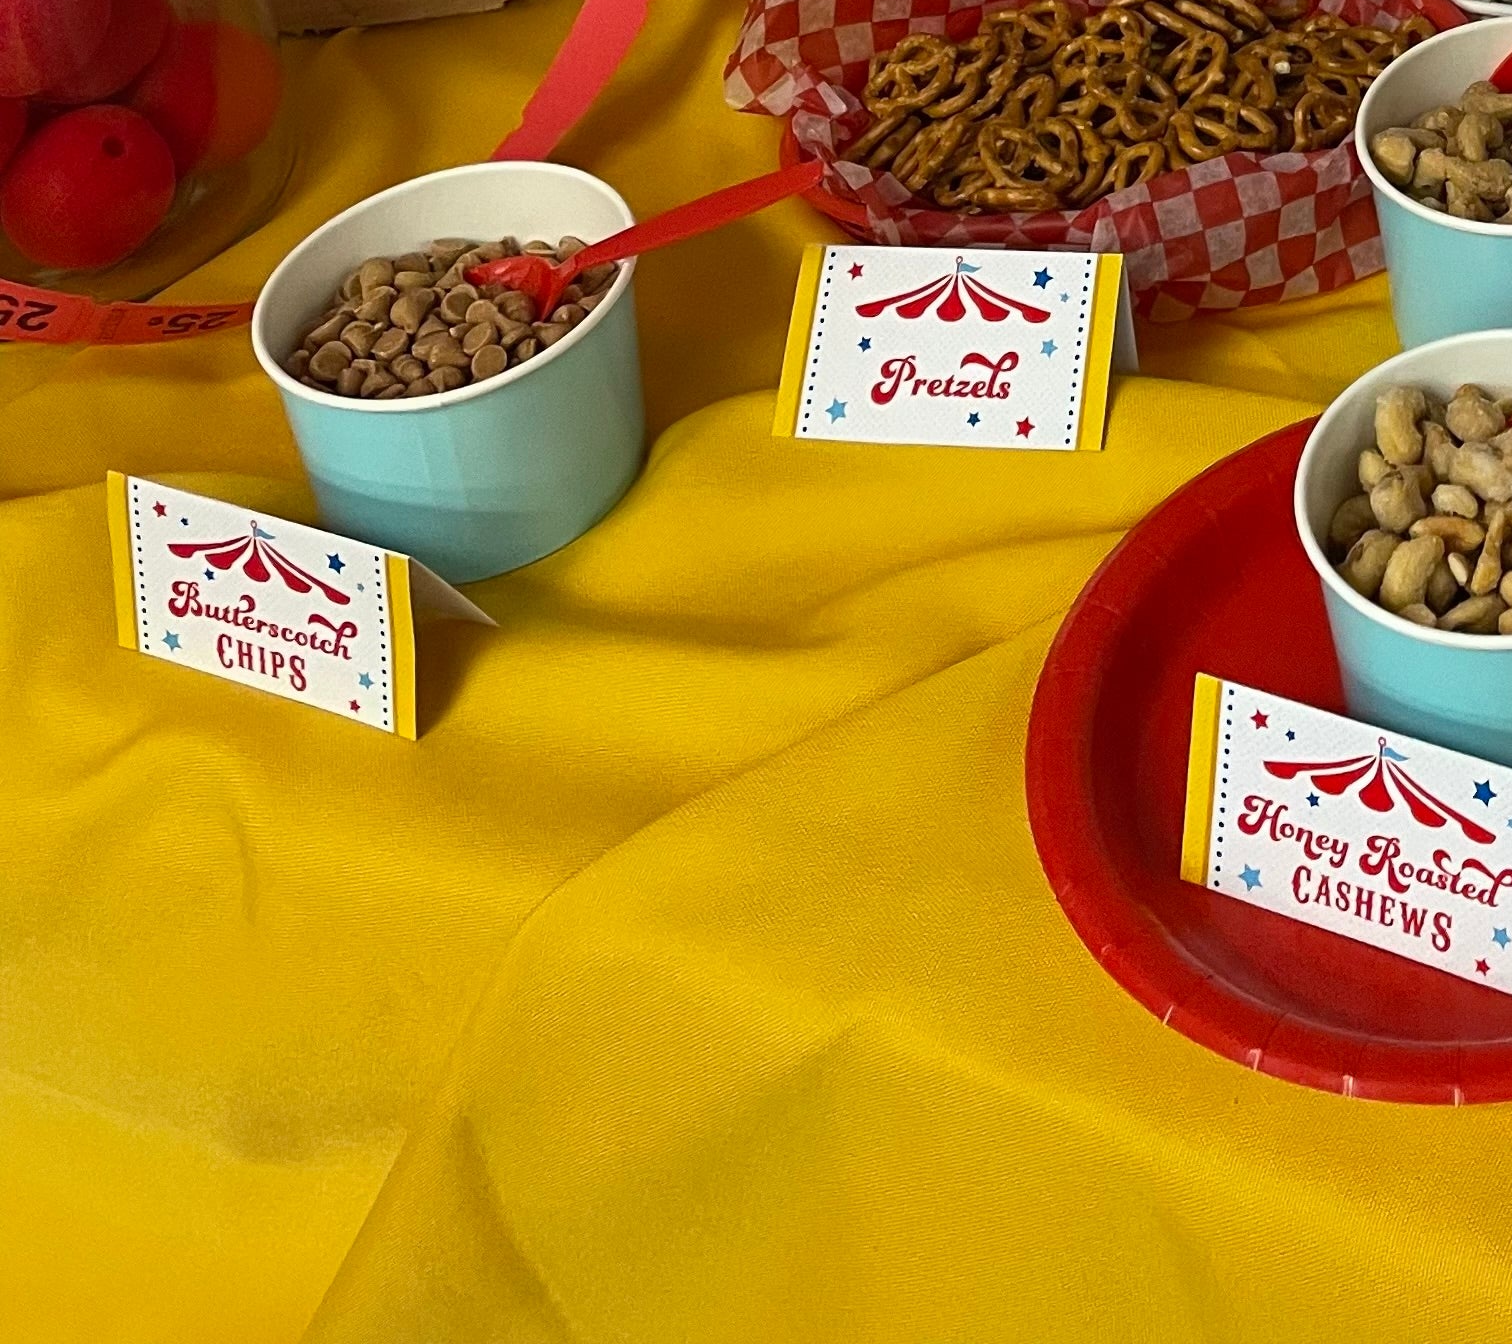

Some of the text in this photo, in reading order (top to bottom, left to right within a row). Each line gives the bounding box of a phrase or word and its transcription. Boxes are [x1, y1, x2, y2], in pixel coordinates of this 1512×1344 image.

[870, 351, 1019, 405] Pretzels
[168, 580, 358, 661] Butterscotch
[216, 632, 308, 692] CHIPS
[1237, 794, 1350, 868] Honey
[1291, 864, 1453, 953] CASHEWS
